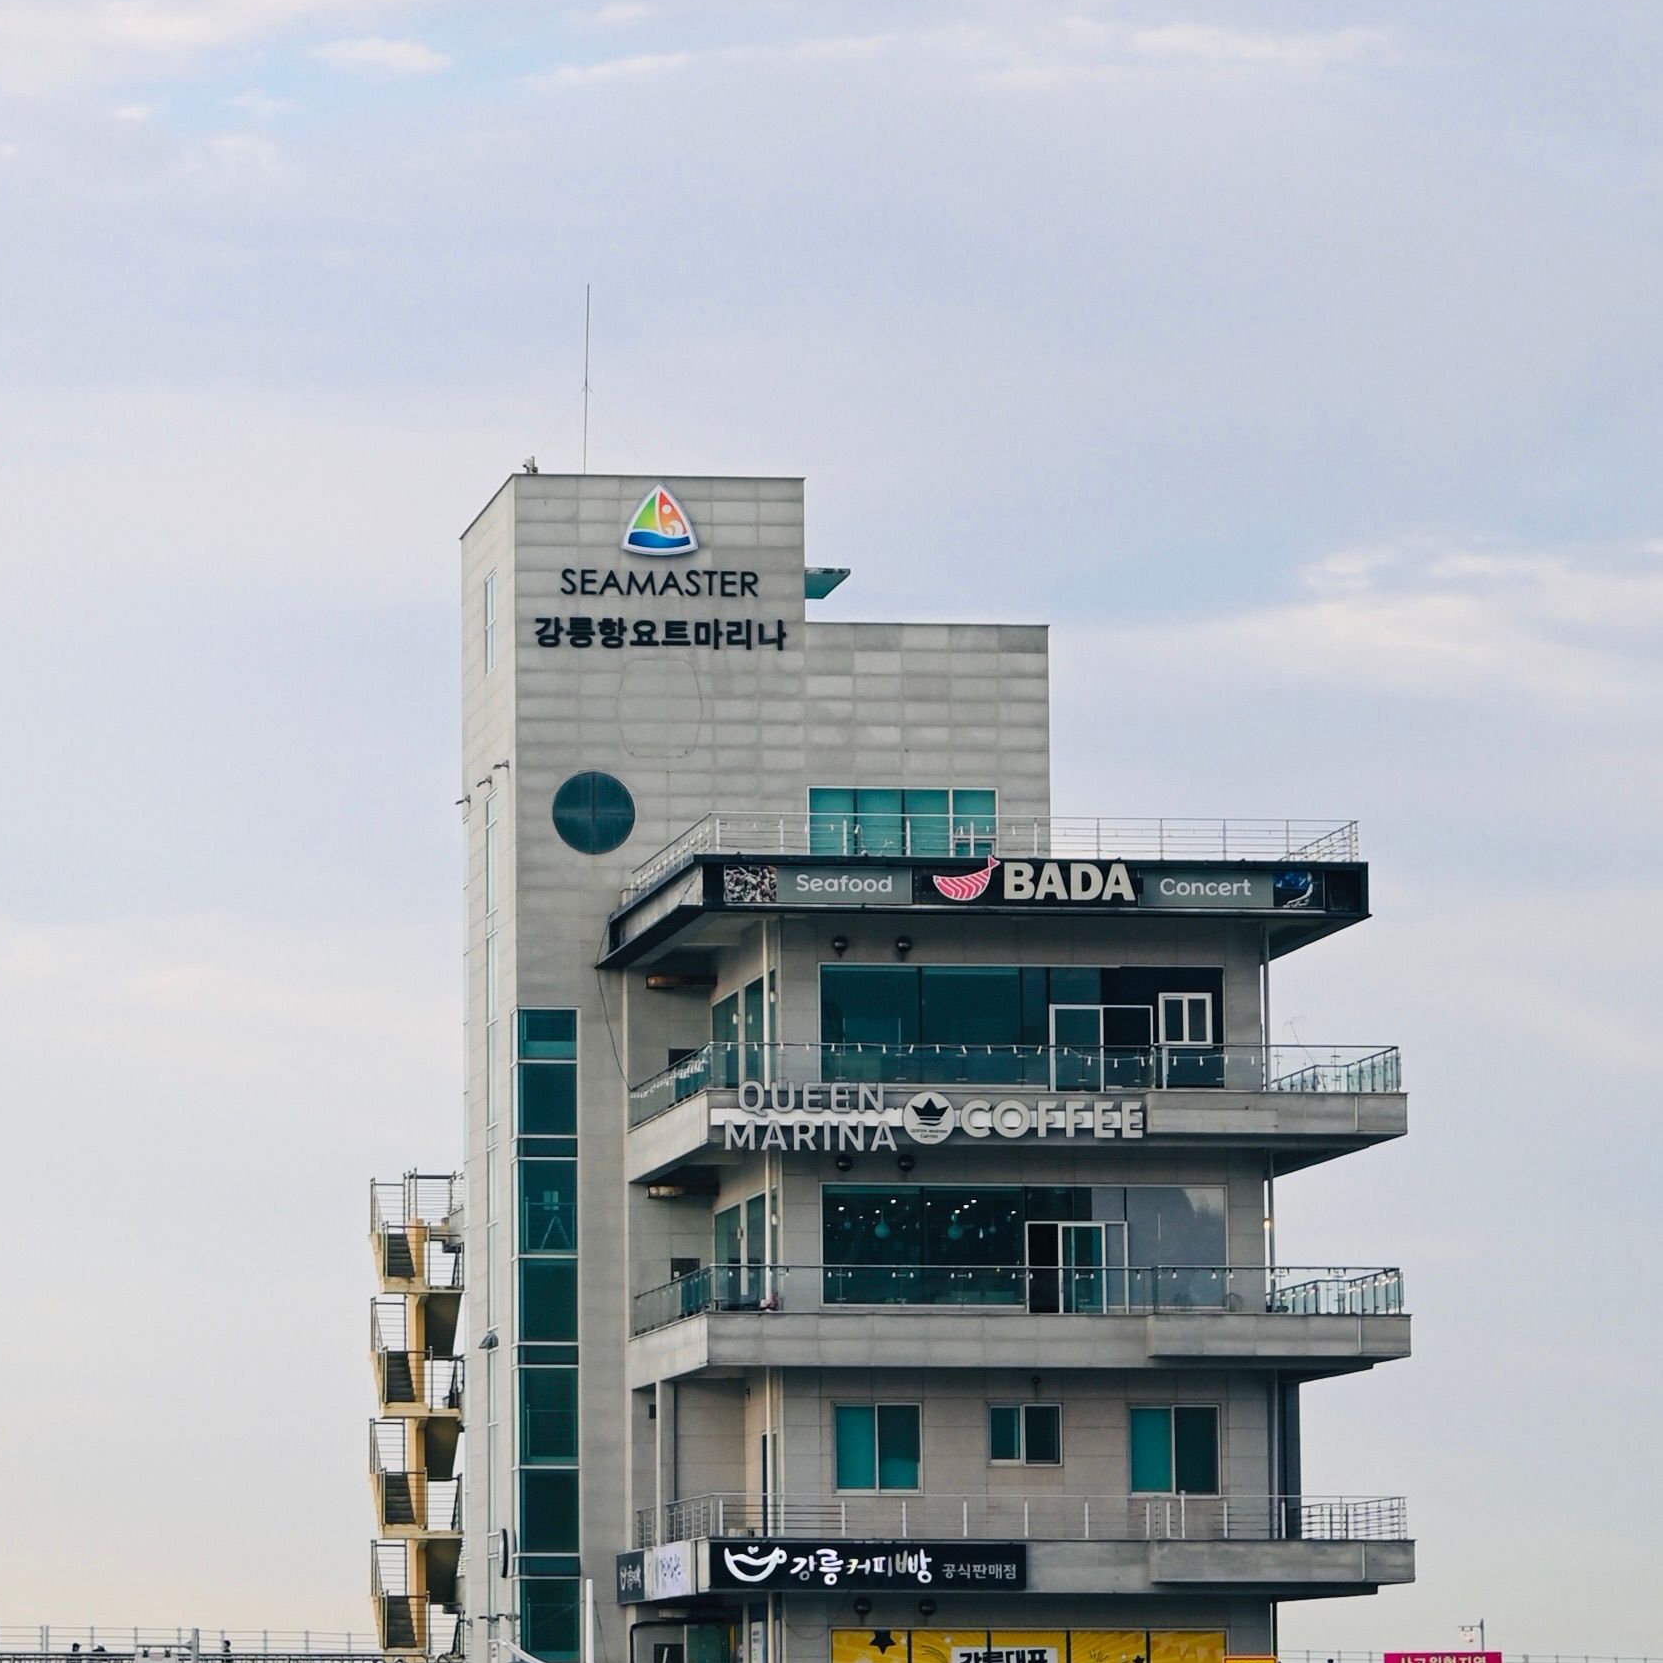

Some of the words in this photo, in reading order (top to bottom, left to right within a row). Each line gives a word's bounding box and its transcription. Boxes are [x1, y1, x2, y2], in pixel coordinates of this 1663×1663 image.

[560, 568, 758, 597] SEAMASTER
[535, 616, 787, 651] 강릉항요트마리나
[795, 872, 893, 894] Seafood
[1003, 861, 1136, 901] BADA
[1159, 877, 1252, 897] Concert
[738, 1080, 885, 1117] QUEEN
[724, 1119, 898, 1152] MARINA
[960, 1099, 1144, 1139] COFFEE
[789, 1548, 932, 1586] 강릉커피빵
[942, 1561, 1018, 1580] 공식판매점
